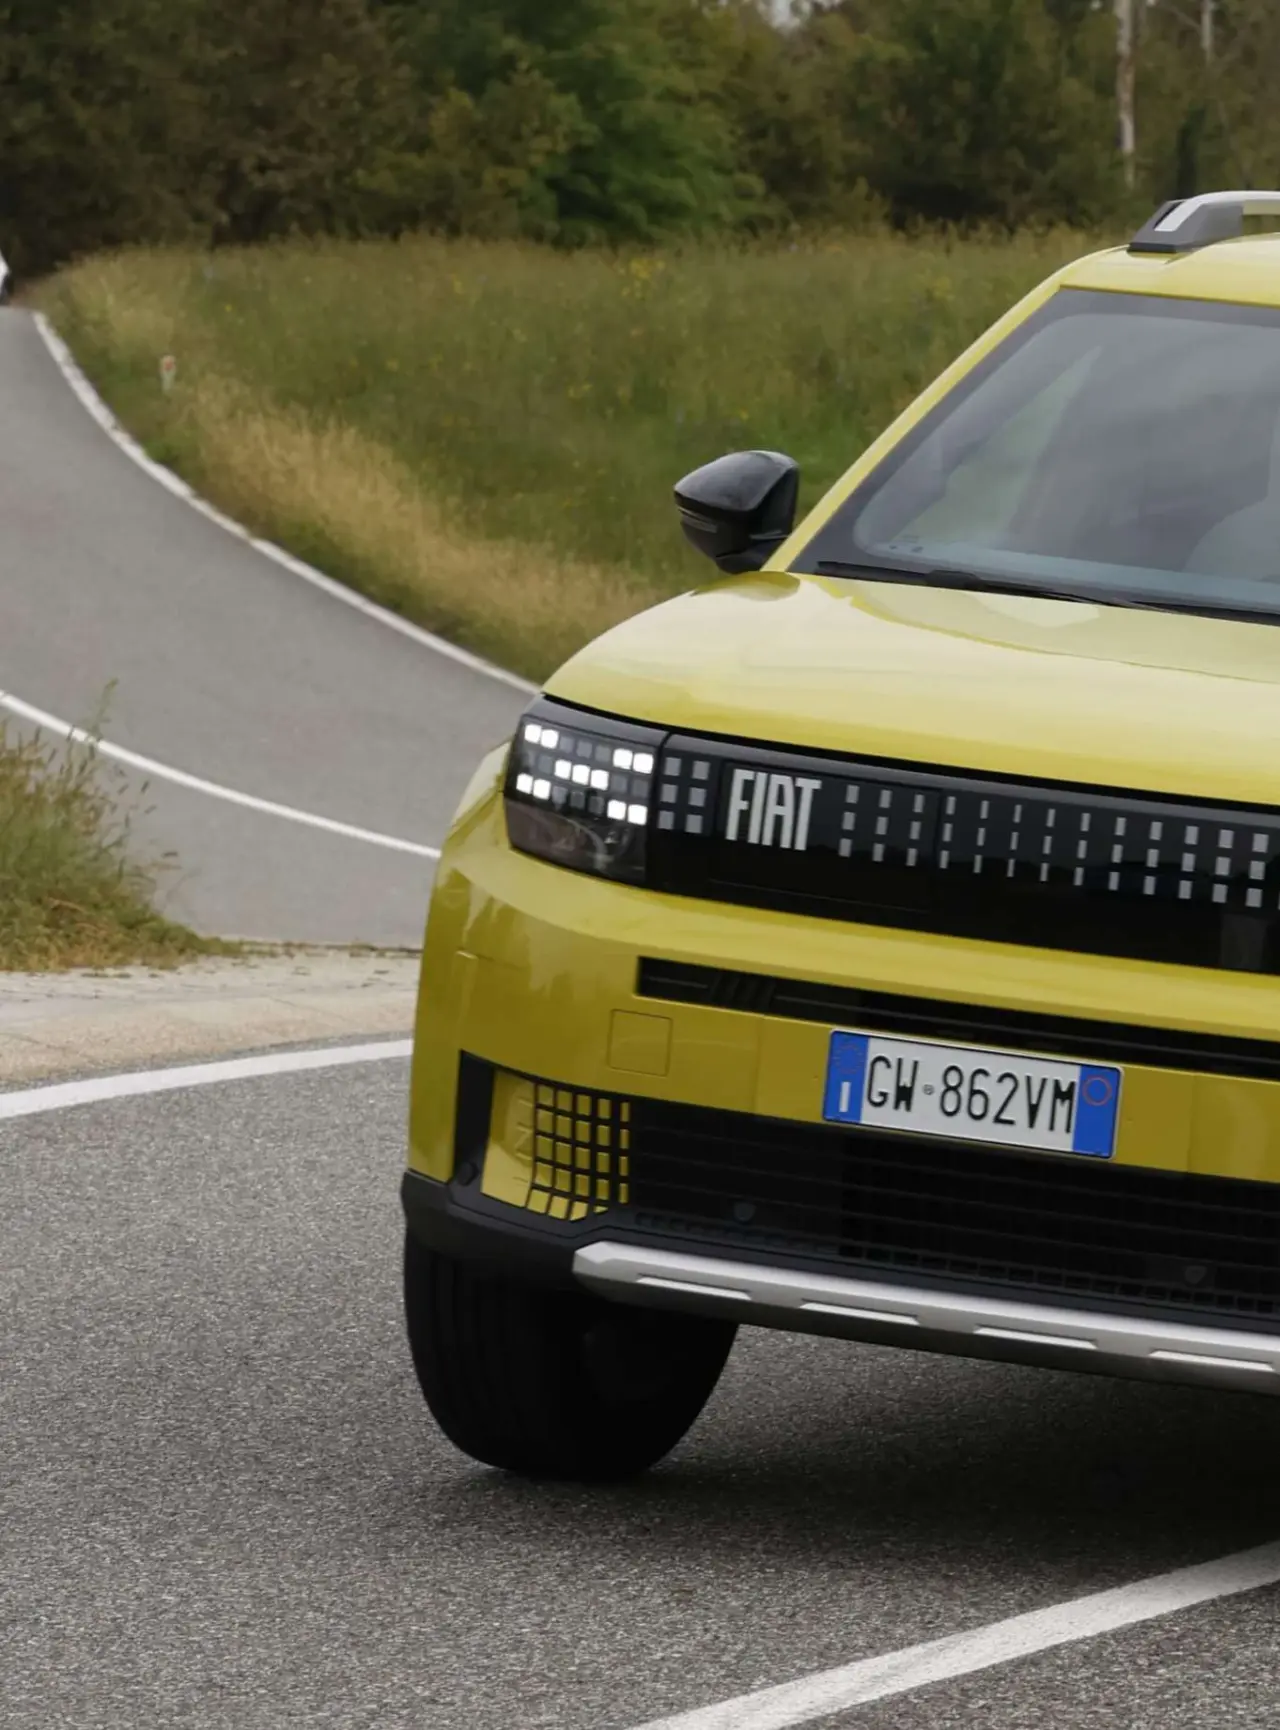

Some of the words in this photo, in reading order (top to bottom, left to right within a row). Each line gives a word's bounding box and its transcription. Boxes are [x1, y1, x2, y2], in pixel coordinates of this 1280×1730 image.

[725, 768, 822, 851] FIAT
[867, 1055, 919, 1112] GW
[939, 1065, 1076, 1133] 862VM
